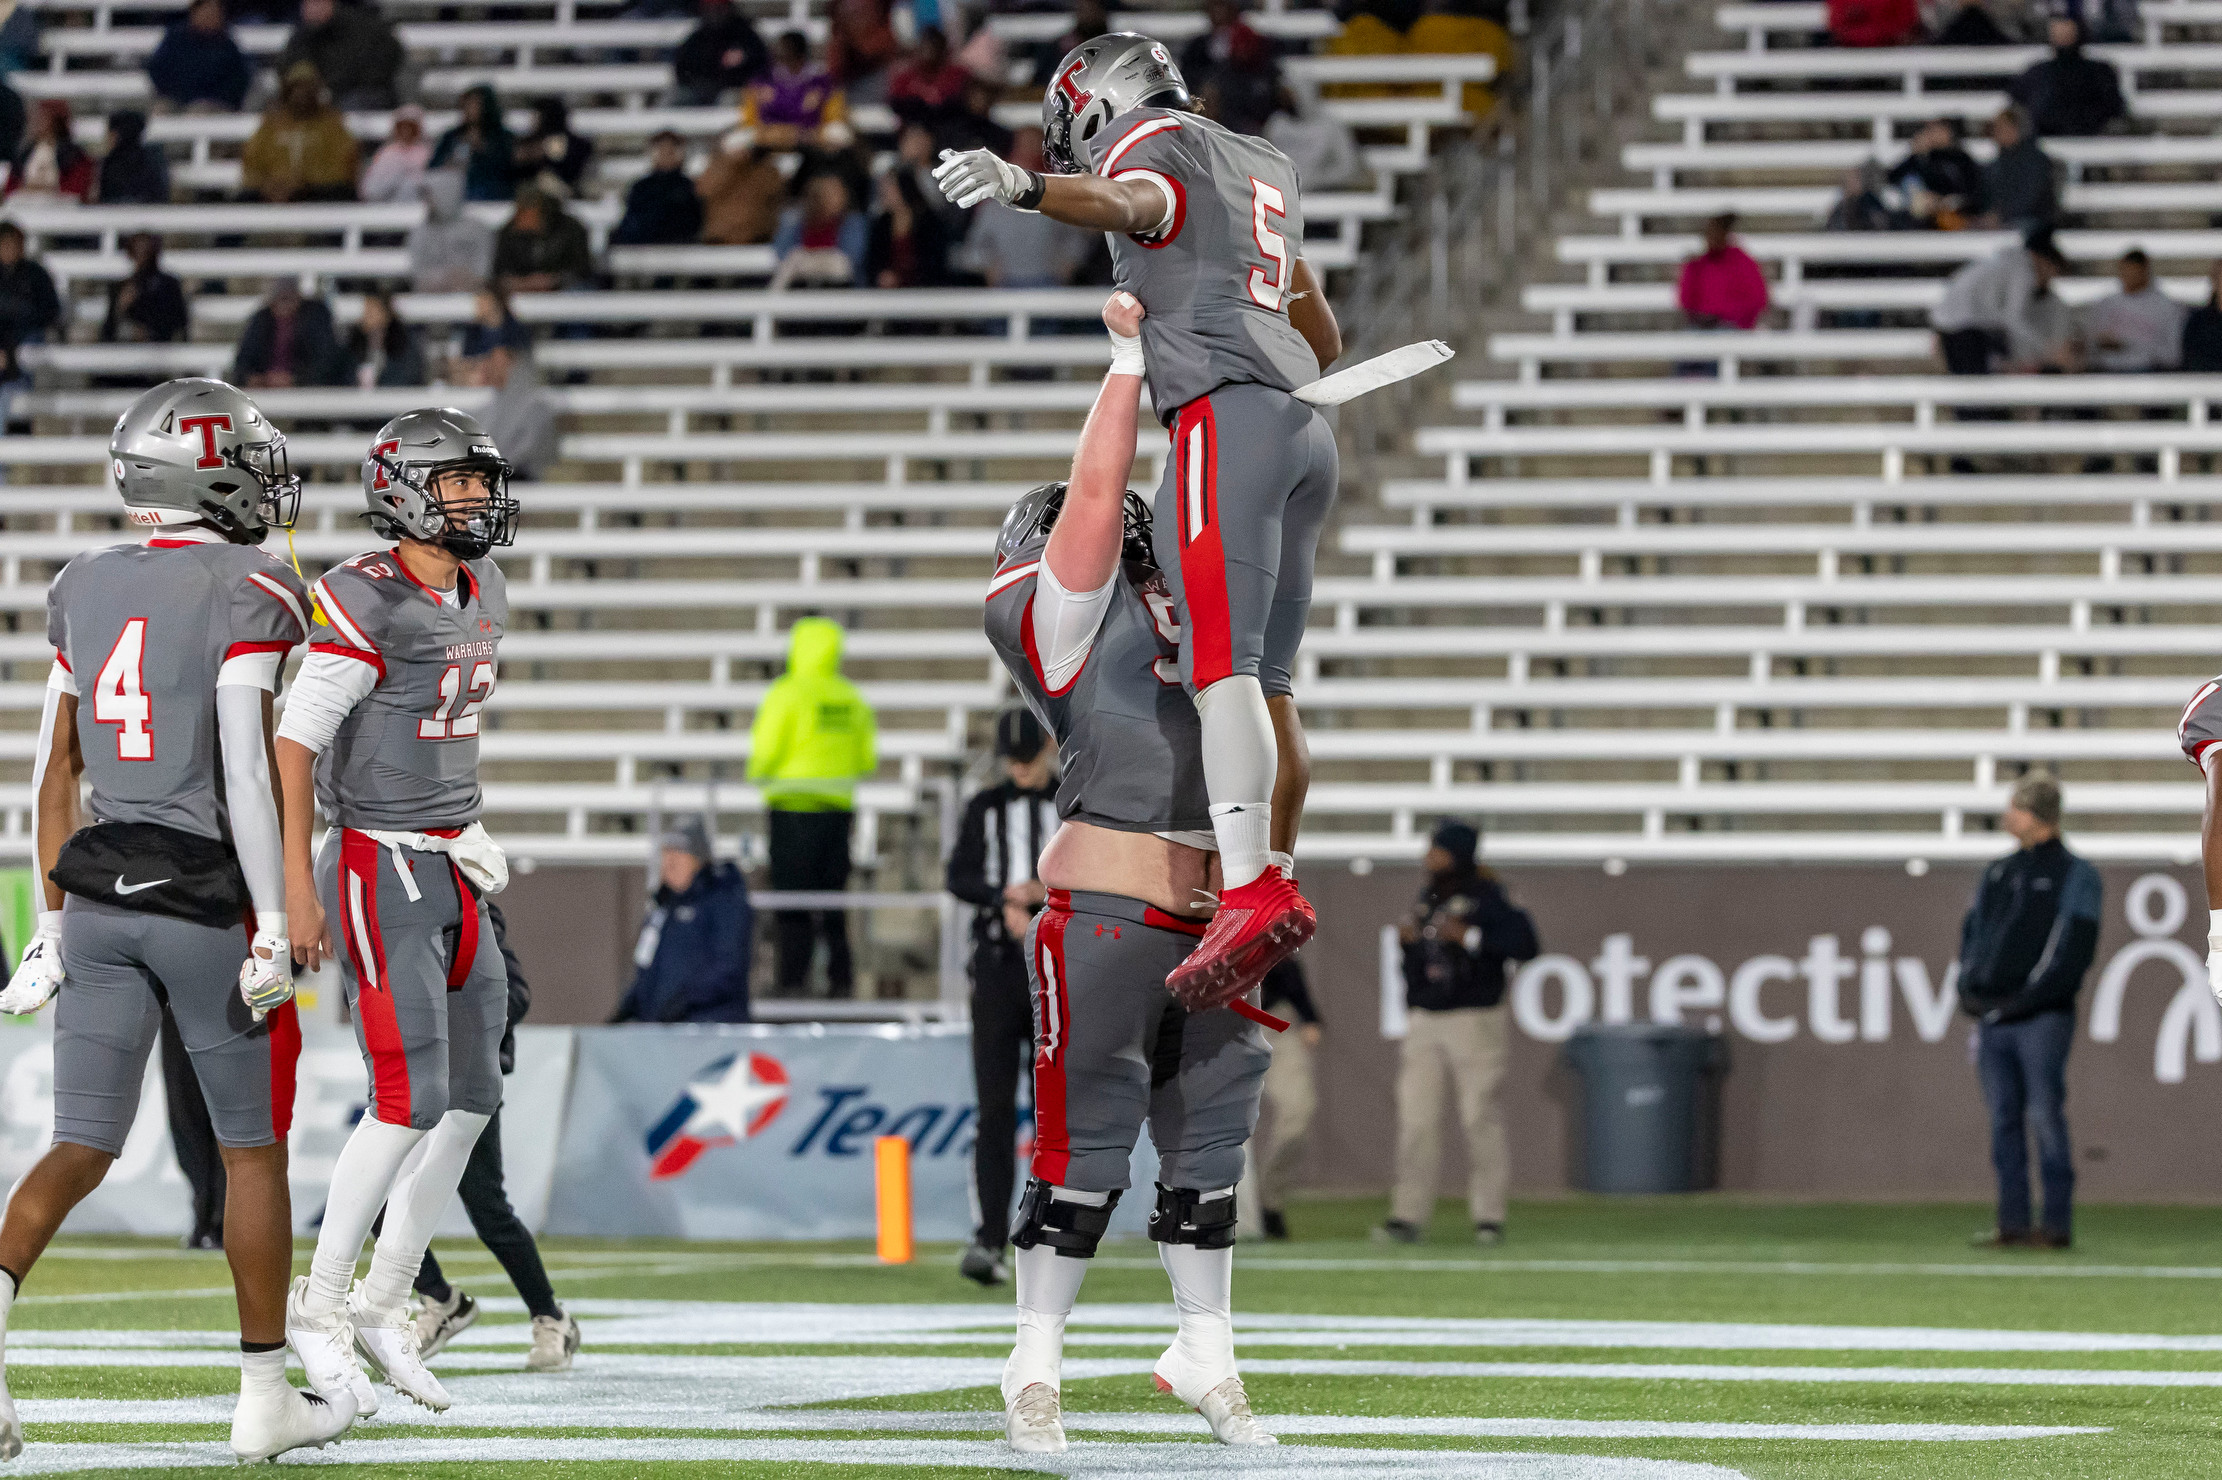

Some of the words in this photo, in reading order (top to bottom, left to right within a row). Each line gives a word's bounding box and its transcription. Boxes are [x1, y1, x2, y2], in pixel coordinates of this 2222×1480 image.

[1050, 56, 1095, 119] T
[1247, 175, 1289, 311] 5
[178, 412, 235, 472] T
[367, 437, 402, 493] T
[472, 445, 499, 457] Ridd
[343, 551, 395, 580] 12
[446, 641, 493, 660] WARRIORS
[94, 617, 155, 763] 4
[416, 661, 496, 740] 12
[1380, 924, 1962, 1043] otectiv
